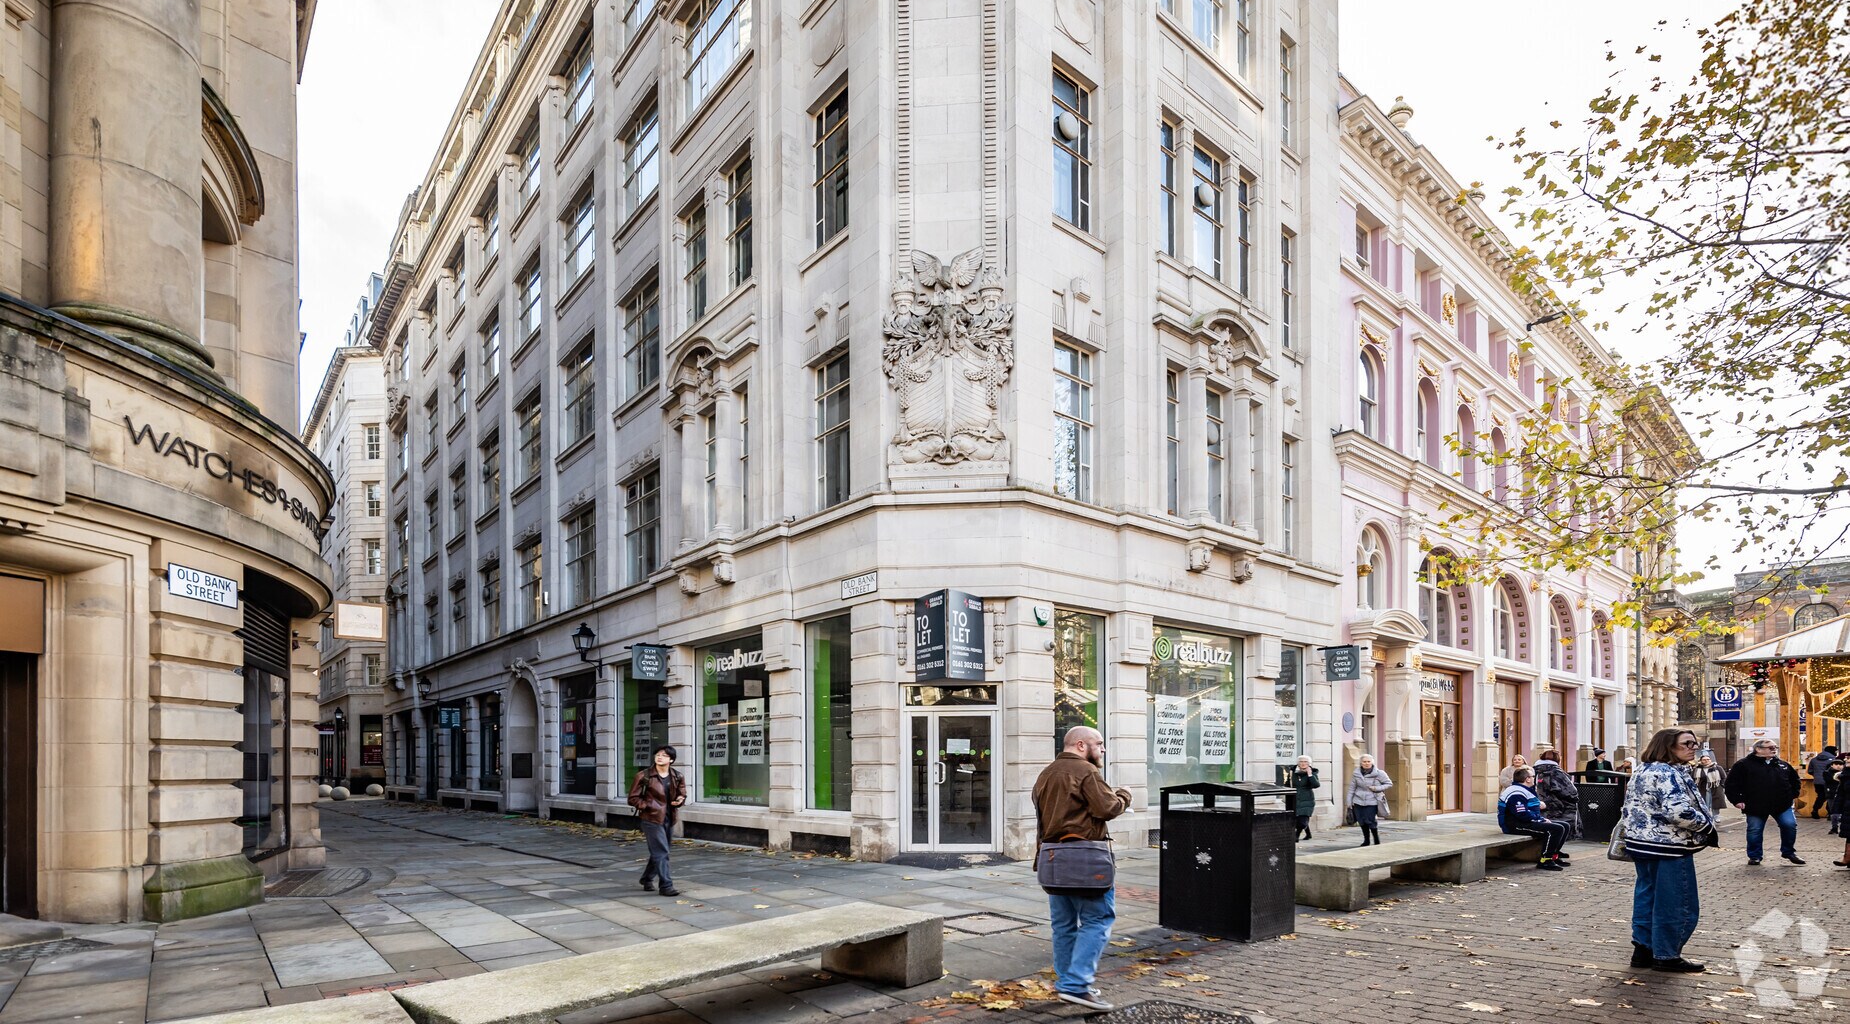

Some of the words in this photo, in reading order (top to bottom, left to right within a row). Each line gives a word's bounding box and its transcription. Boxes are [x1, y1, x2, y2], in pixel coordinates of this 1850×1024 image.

[124, 414, 277, 504] WATCHES
[177, 568, 200, 584] OLD
[204, 575, 232, 592] BANK
[844, 580, 855, 589] OLD
[858, 574, 875, 585] BANK
[186, 584, 225, 602] STREET
[848, 584, 870, 596] STREET
[917, 615, 929, 631] TO
[952, 610, 967, 627] TO
[917, 629, 932, 646] LET
[952, 626, 970, 643] LET
[716, 648, 765, 672] realbuzz
[1173, 641, 1232, 666] realbuzz
